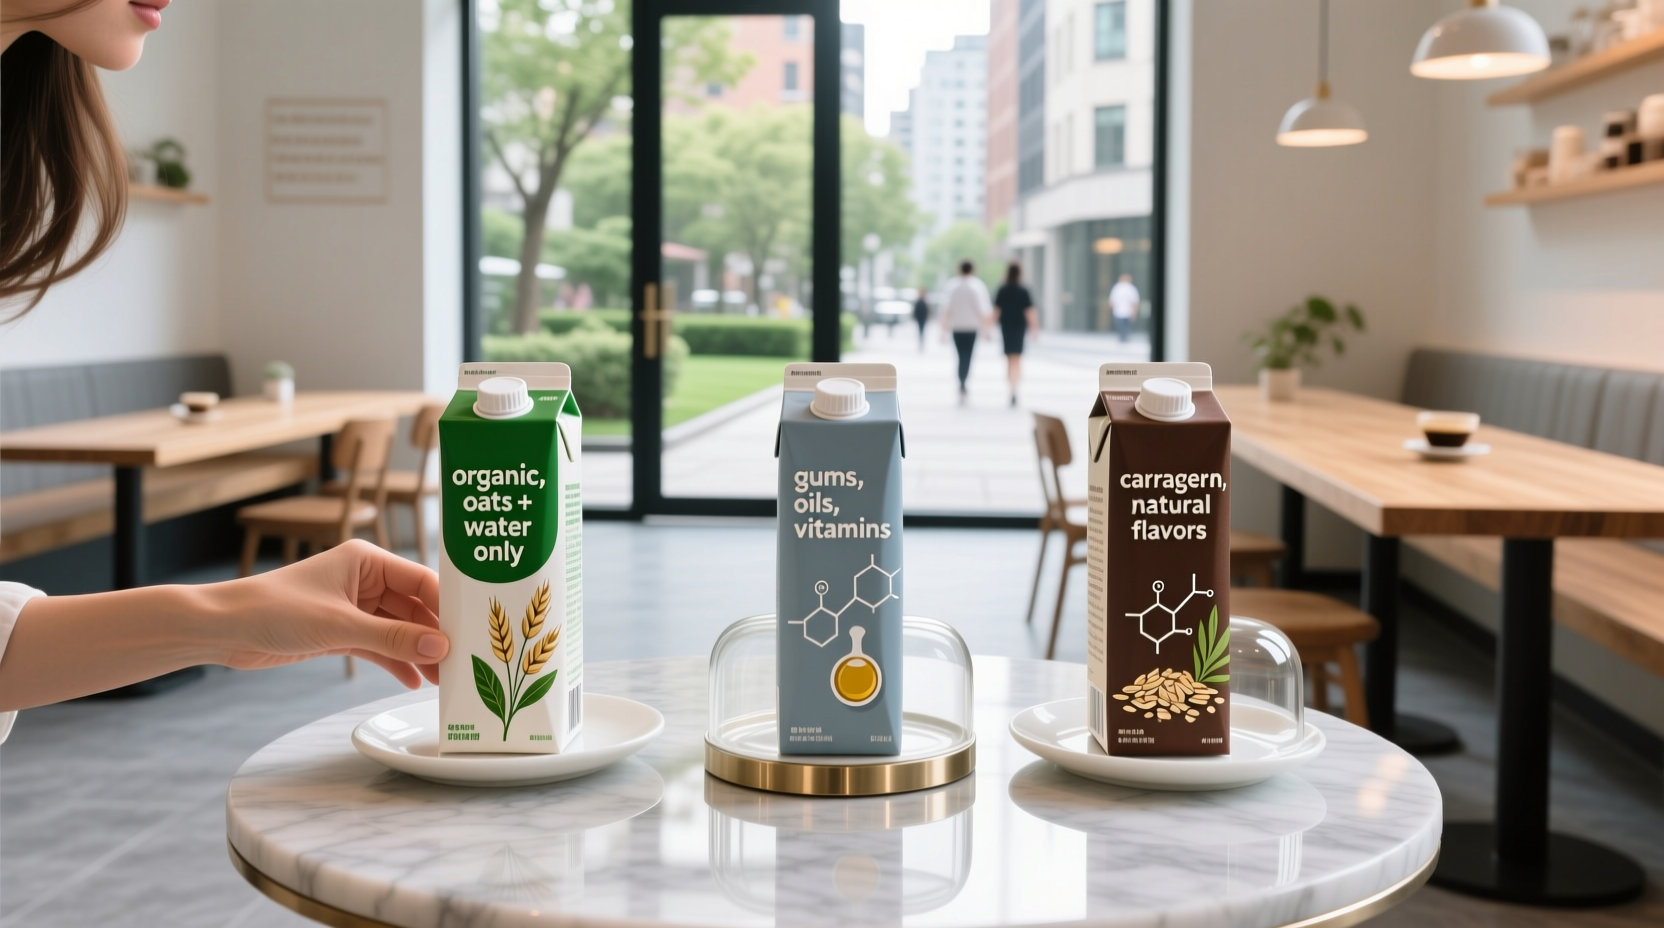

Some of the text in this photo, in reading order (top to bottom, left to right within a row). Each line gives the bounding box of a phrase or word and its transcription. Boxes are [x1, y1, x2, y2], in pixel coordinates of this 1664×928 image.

[452, 463, 546, 492] organic,
[794, 470, 864, 493] gums,
[1120, 472, 1227, 494] carragern,
[463, 491, 533, 512] oats +
[794, 491, 840, 517] oils,
[1131, 493, 1211, 515] natural
[464, 517, 533, 537] water
[794, 517, 892, 539] vitamins
[1131, 519, 1207, 540] flavors
[473, 540, 525, 568] only
